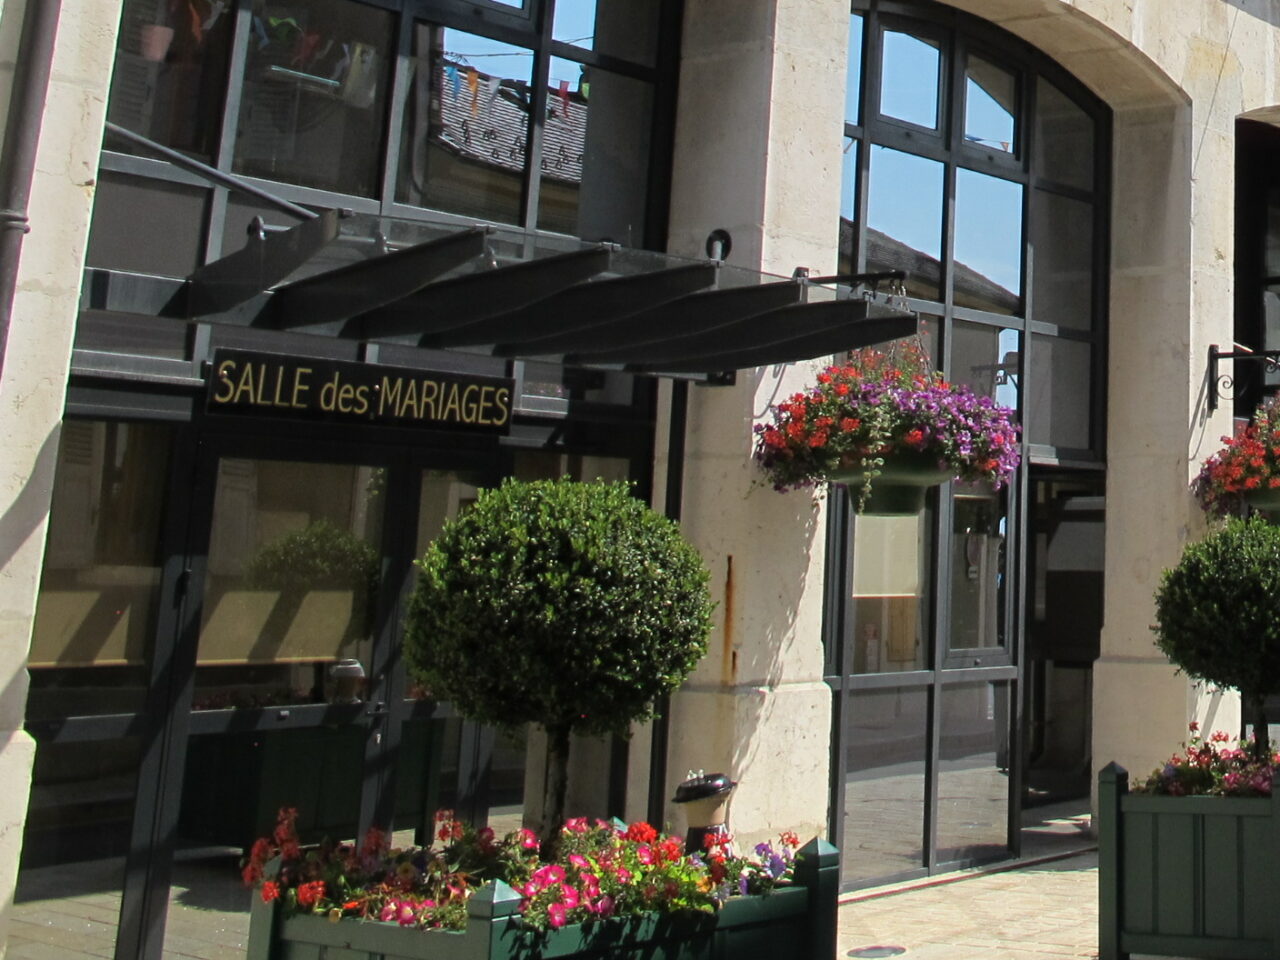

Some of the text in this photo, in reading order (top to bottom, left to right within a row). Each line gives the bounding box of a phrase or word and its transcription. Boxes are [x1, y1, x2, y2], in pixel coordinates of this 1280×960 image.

[214, 360, 509, 427] SALLE des MARIAGES
